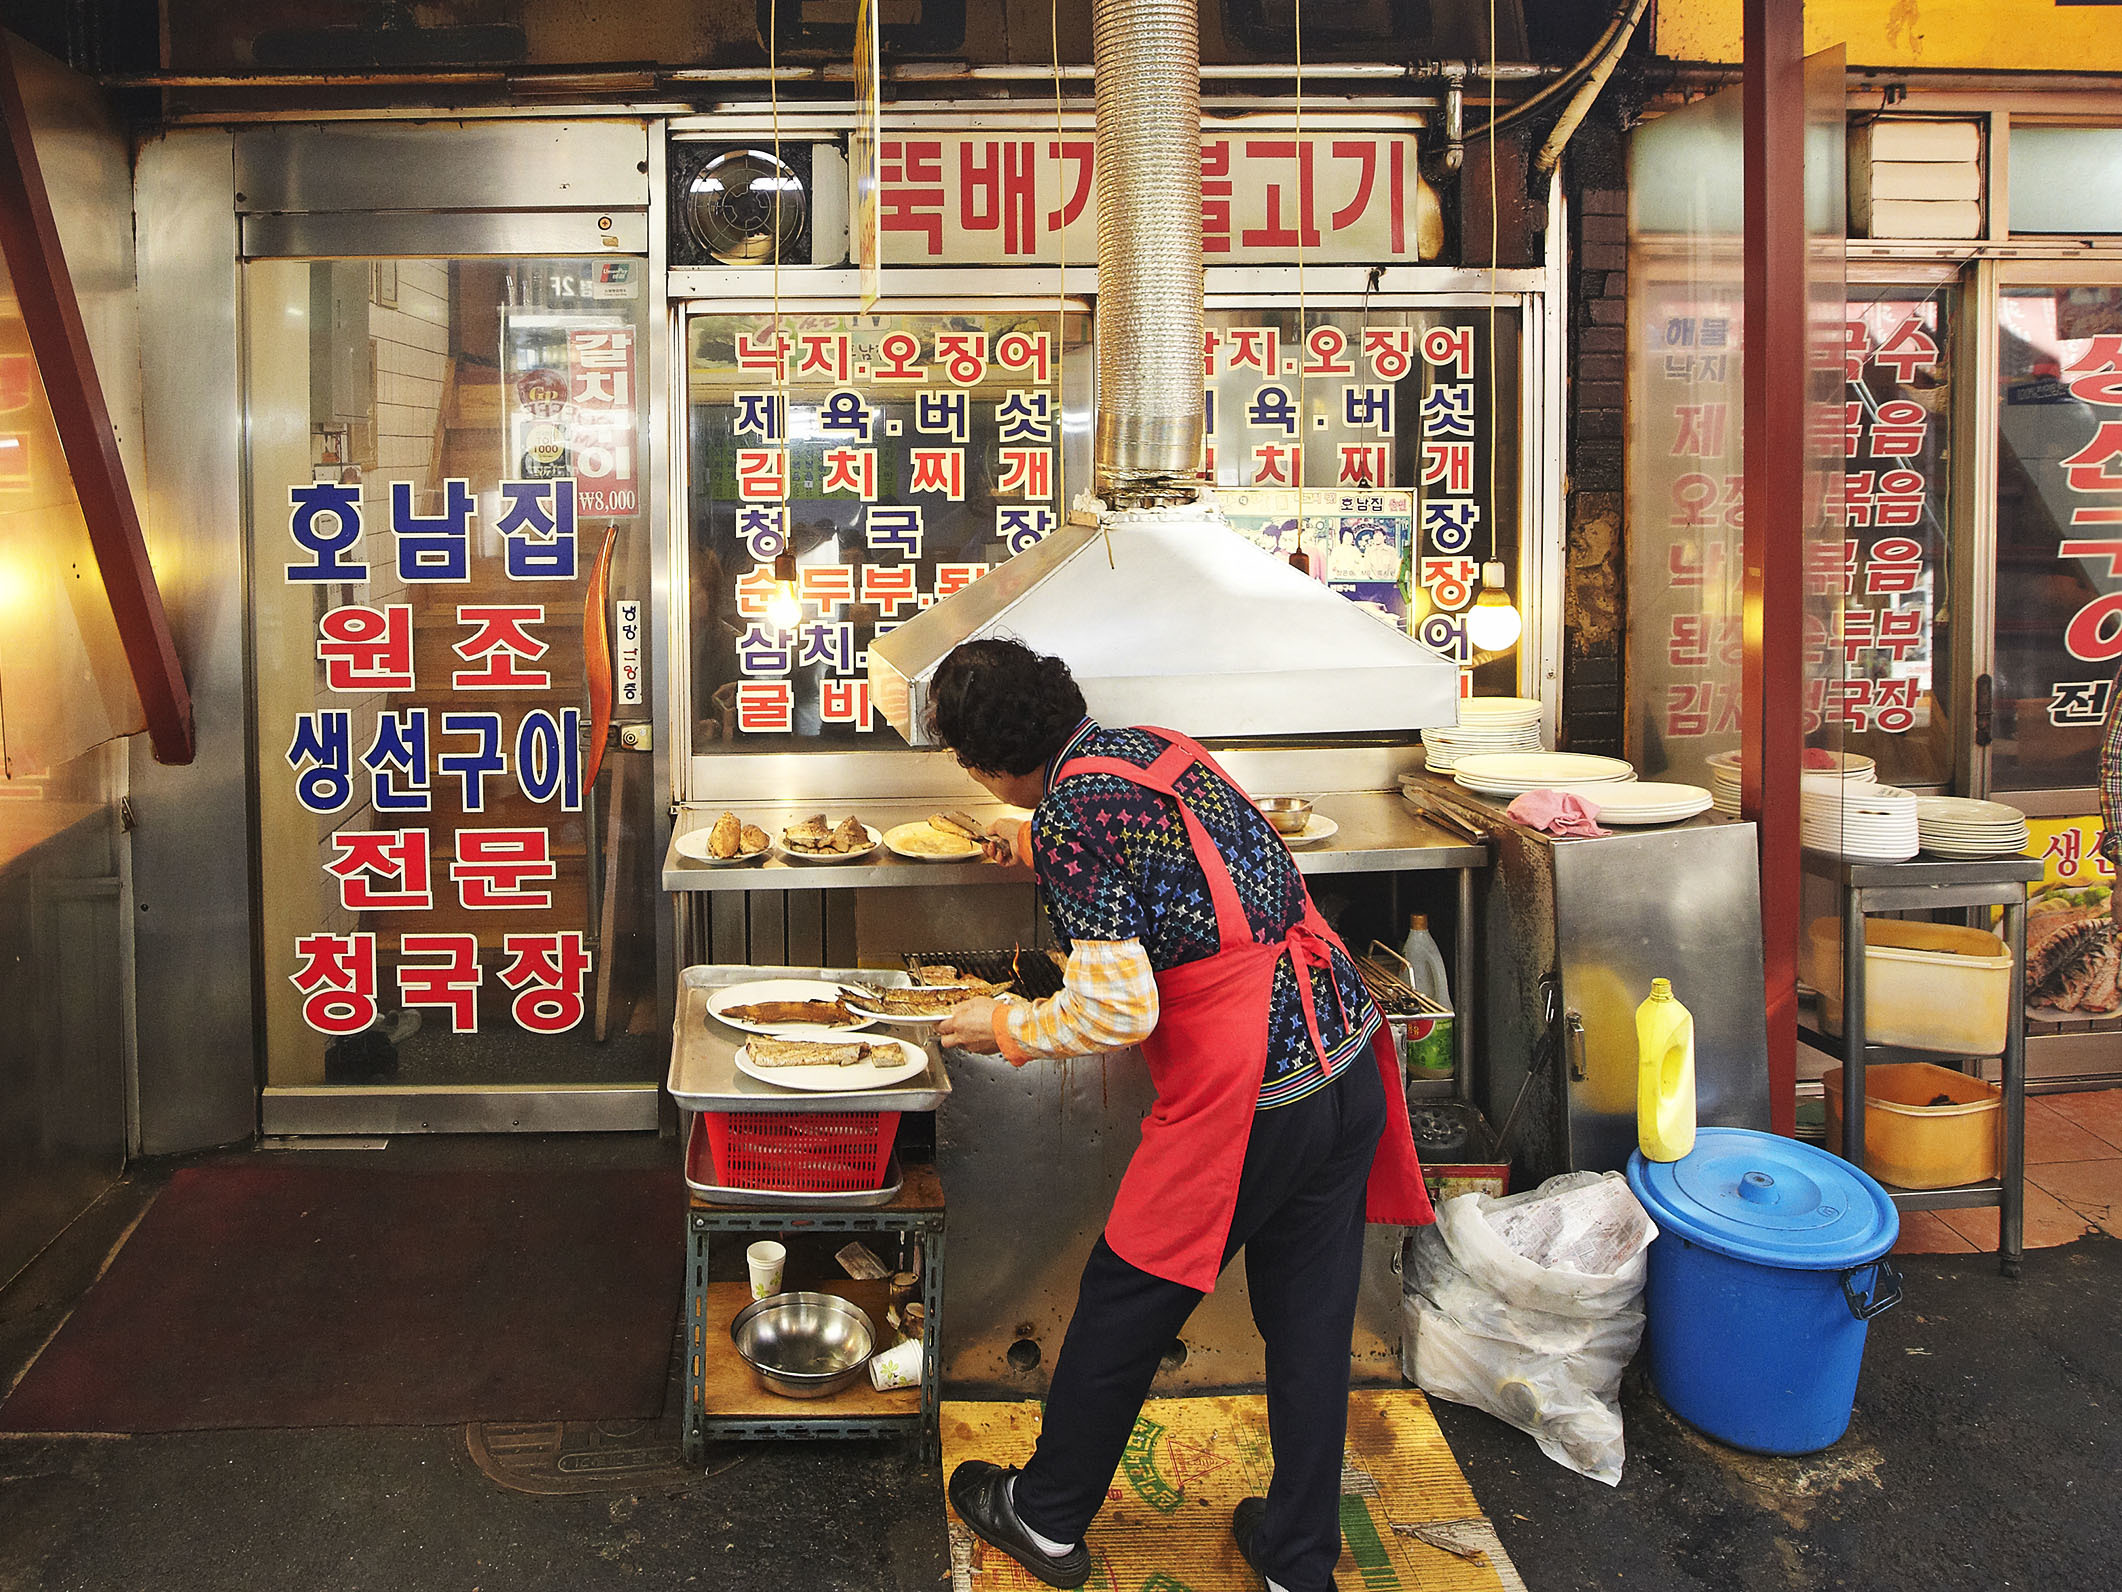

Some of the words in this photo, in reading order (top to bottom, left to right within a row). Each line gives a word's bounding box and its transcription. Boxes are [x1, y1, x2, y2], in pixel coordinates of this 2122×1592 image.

[1665, 353, 1727, 383] 낙지
[1666, 317, 1729, 346] 해물
[284, 477, 579, 584] 호남집
[735, 506, 1056, 561] 청국장
[1340, 496, 1384, 512] 호남집
[317, 603, 551, 692] 원조
[285, 707, 583, 814] 생선구이
[322, 827, 556, 910] 전문
[289, 931, 592, 1035] 청국장
